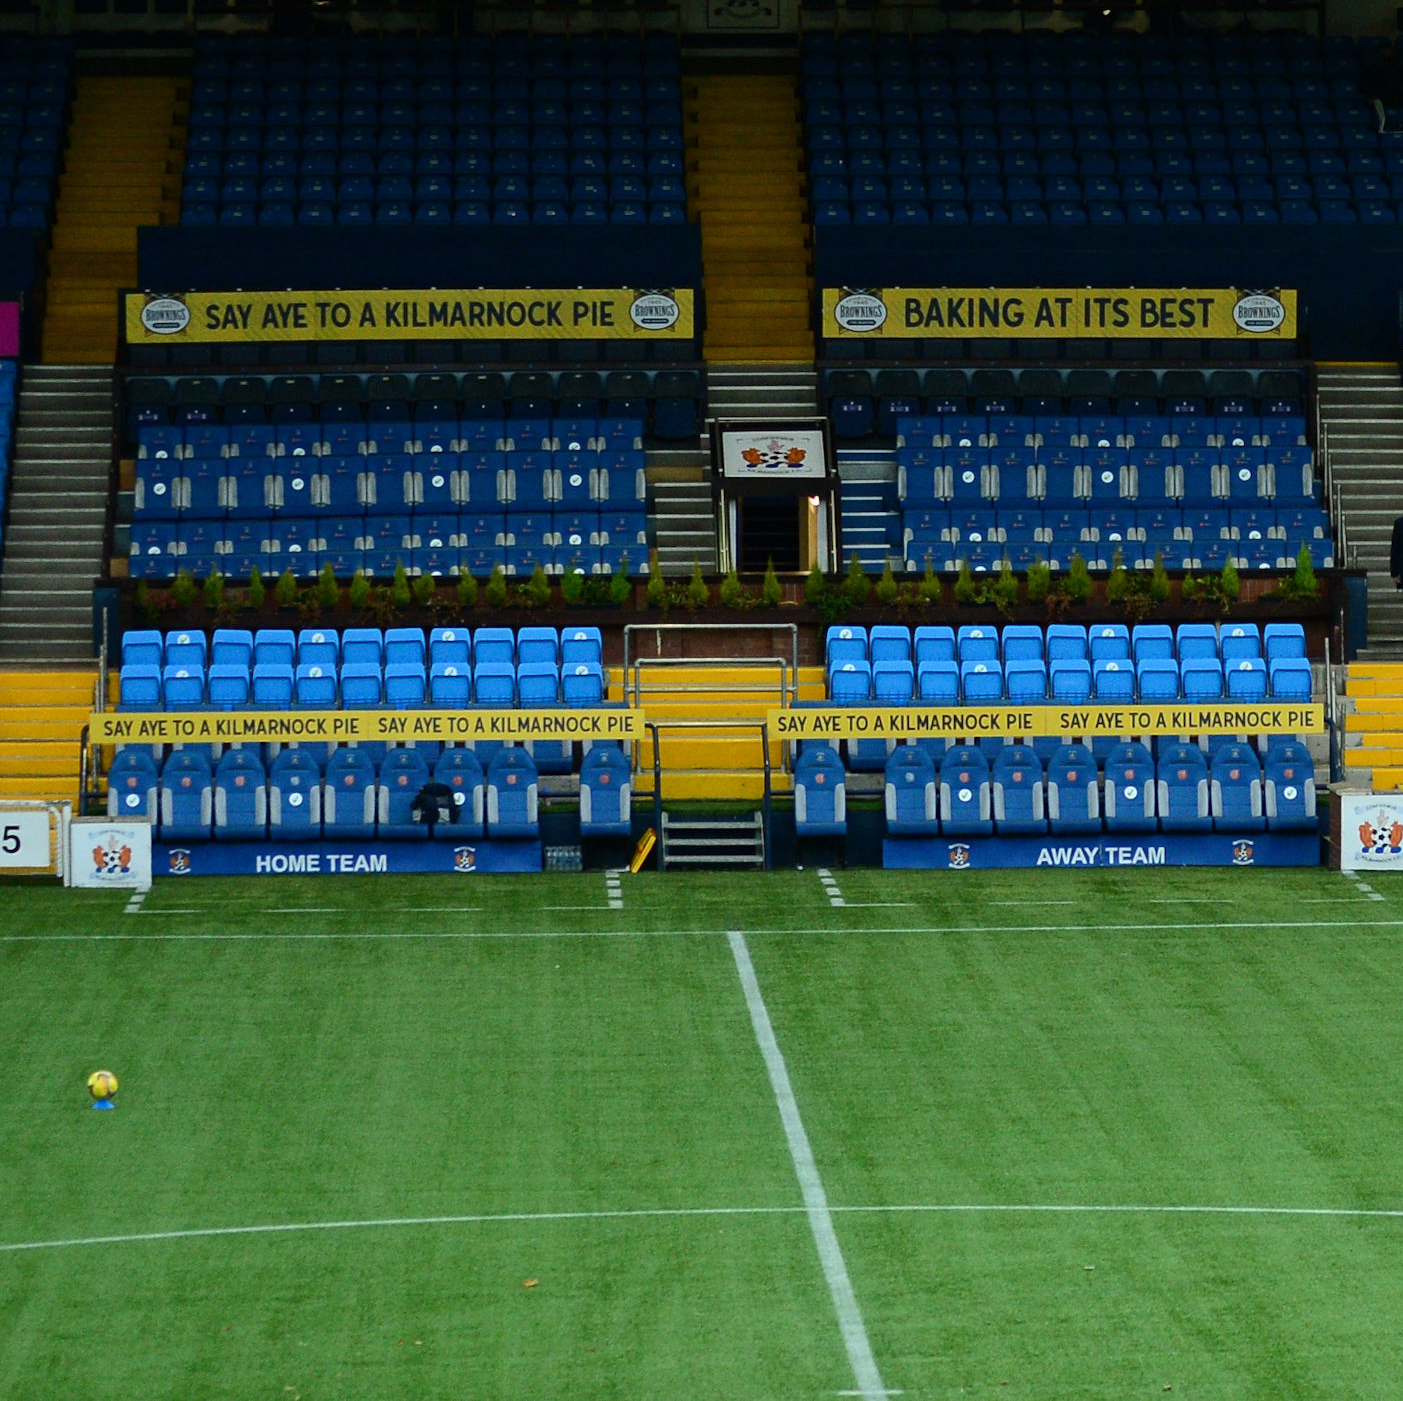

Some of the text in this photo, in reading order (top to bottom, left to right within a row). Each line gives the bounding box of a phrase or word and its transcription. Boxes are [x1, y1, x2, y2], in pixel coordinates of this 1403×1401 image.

[206, 301, 615, 330] SAY AYE TO A KILMARNOCK PIE
[634, 304, 675, 317] BROWNINGS
[840, 305, 883, 318] BROWNINGS
[905, 298, 1215, 327] BAKING AT ITS BEST
[1238, 305, 1280, 318] BROWNINGS
[104, 718, 359, 737] SAY AYE TO A KILMARNOCK PIE
[378, 716, 634, 733] SAY AYE TO A KILMARNOCK PIE
[778, 714, 1032, 732] SAY AYE TO A KILMARNOCK PIE
[1060, 711, 1314, 728] SAY AYE TO A KILMARNOCK PIE
[2, 825, 21, 854] 5
[256, 854, 388, 873] HOME TEAM
[1036, 846, 1166, 865] AWAY TEAM
